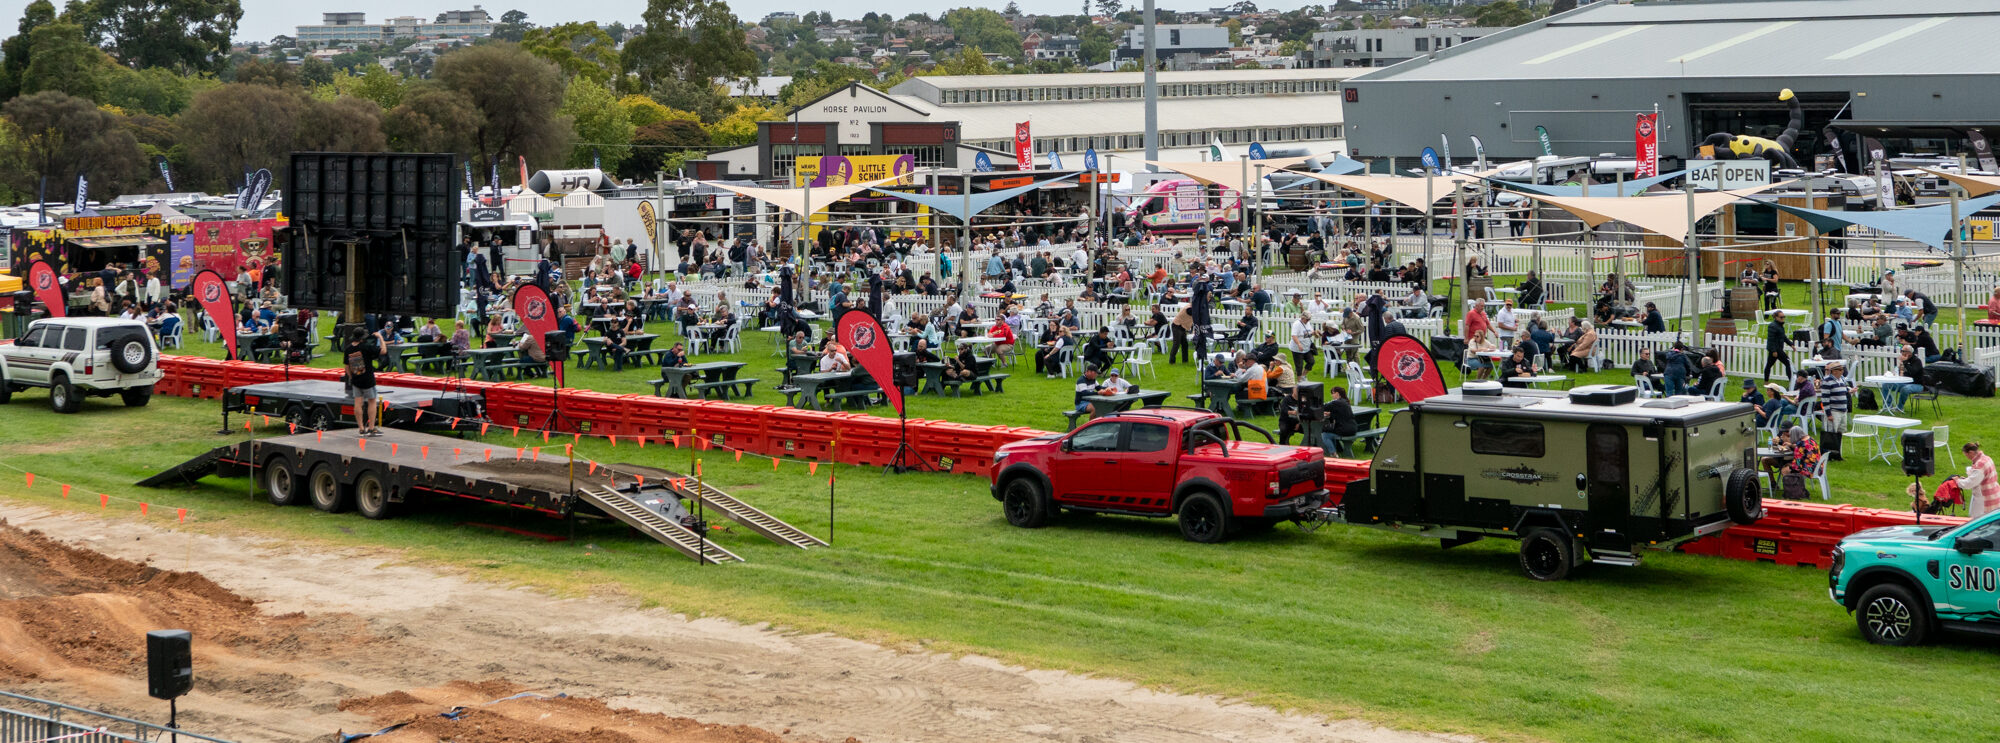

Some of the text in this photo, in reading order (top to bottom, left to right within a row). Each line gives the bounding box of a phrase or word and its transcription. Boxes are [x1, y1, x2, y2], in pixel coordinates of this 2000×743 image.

[1346, 89, 1357, 101] 01
[823, 105, 887, 113] HORSE PAVILION
[944, 128, 955, 140] 02
[862, 164, 886, 172] LITTLE
[858, 173, 886, 181] SCHNIT
[1691, 168, 1764, 182] BAR OPEN
[488, 209, 500, 217] CITY
[106, 215, 141, 228] BURGERS
[1948, 563, 2000, 593] SNO
